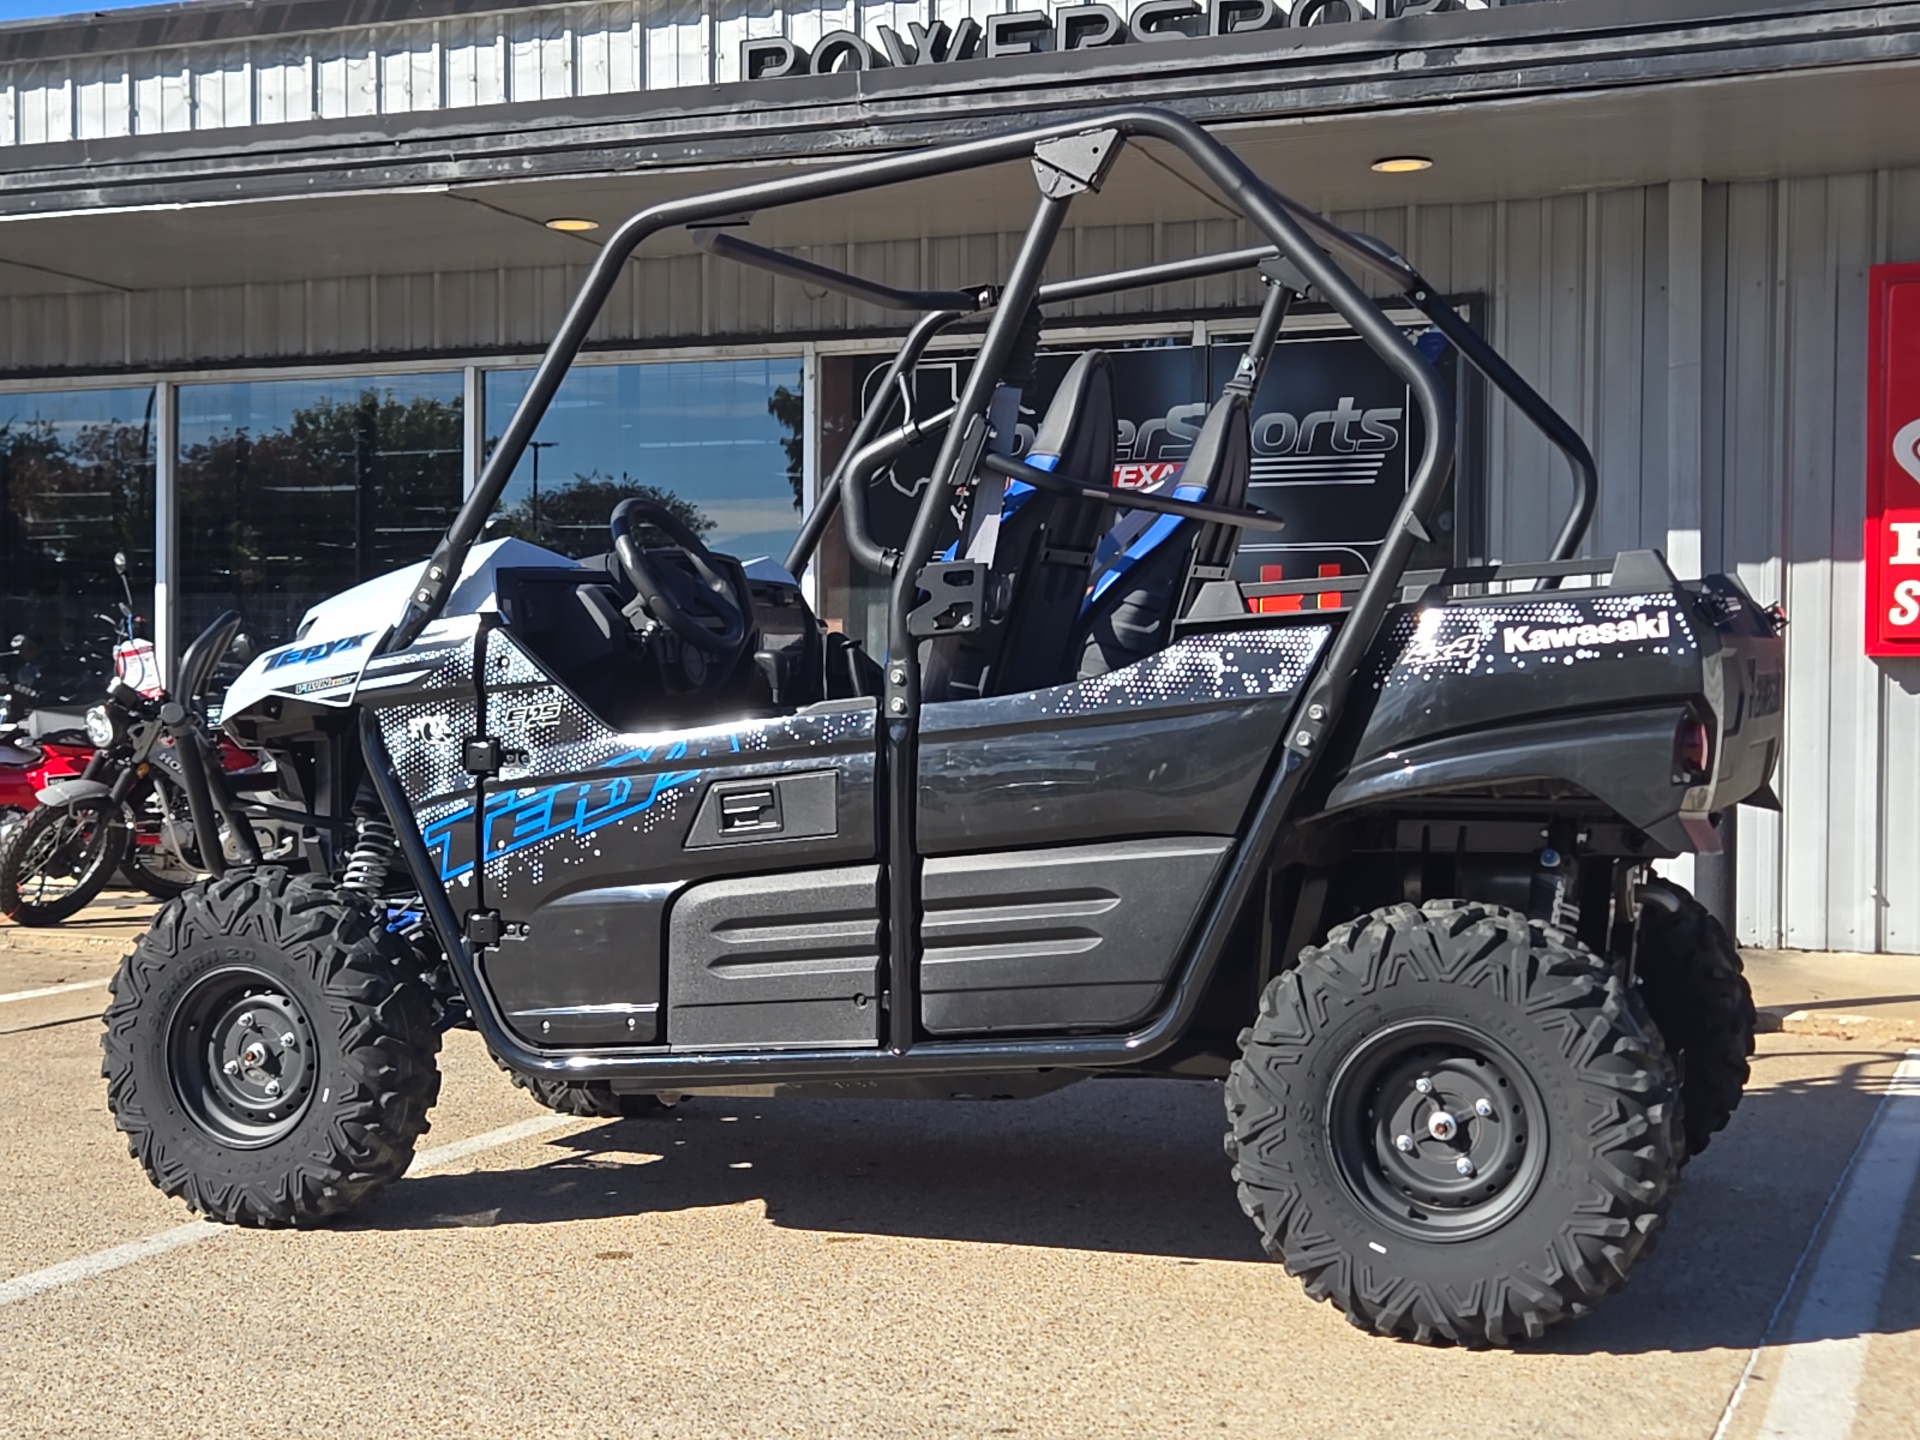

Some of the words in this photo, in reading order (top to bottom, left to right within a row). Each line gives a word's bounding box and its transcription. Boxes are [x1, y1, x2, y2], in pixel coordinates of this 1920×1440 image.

[1503, 611, 1671, 655] Kawasaki
[505, 702, 562, 725] EPS
[408, 713, 451, 744] FOX
[158, 752, 184, 774] HO
